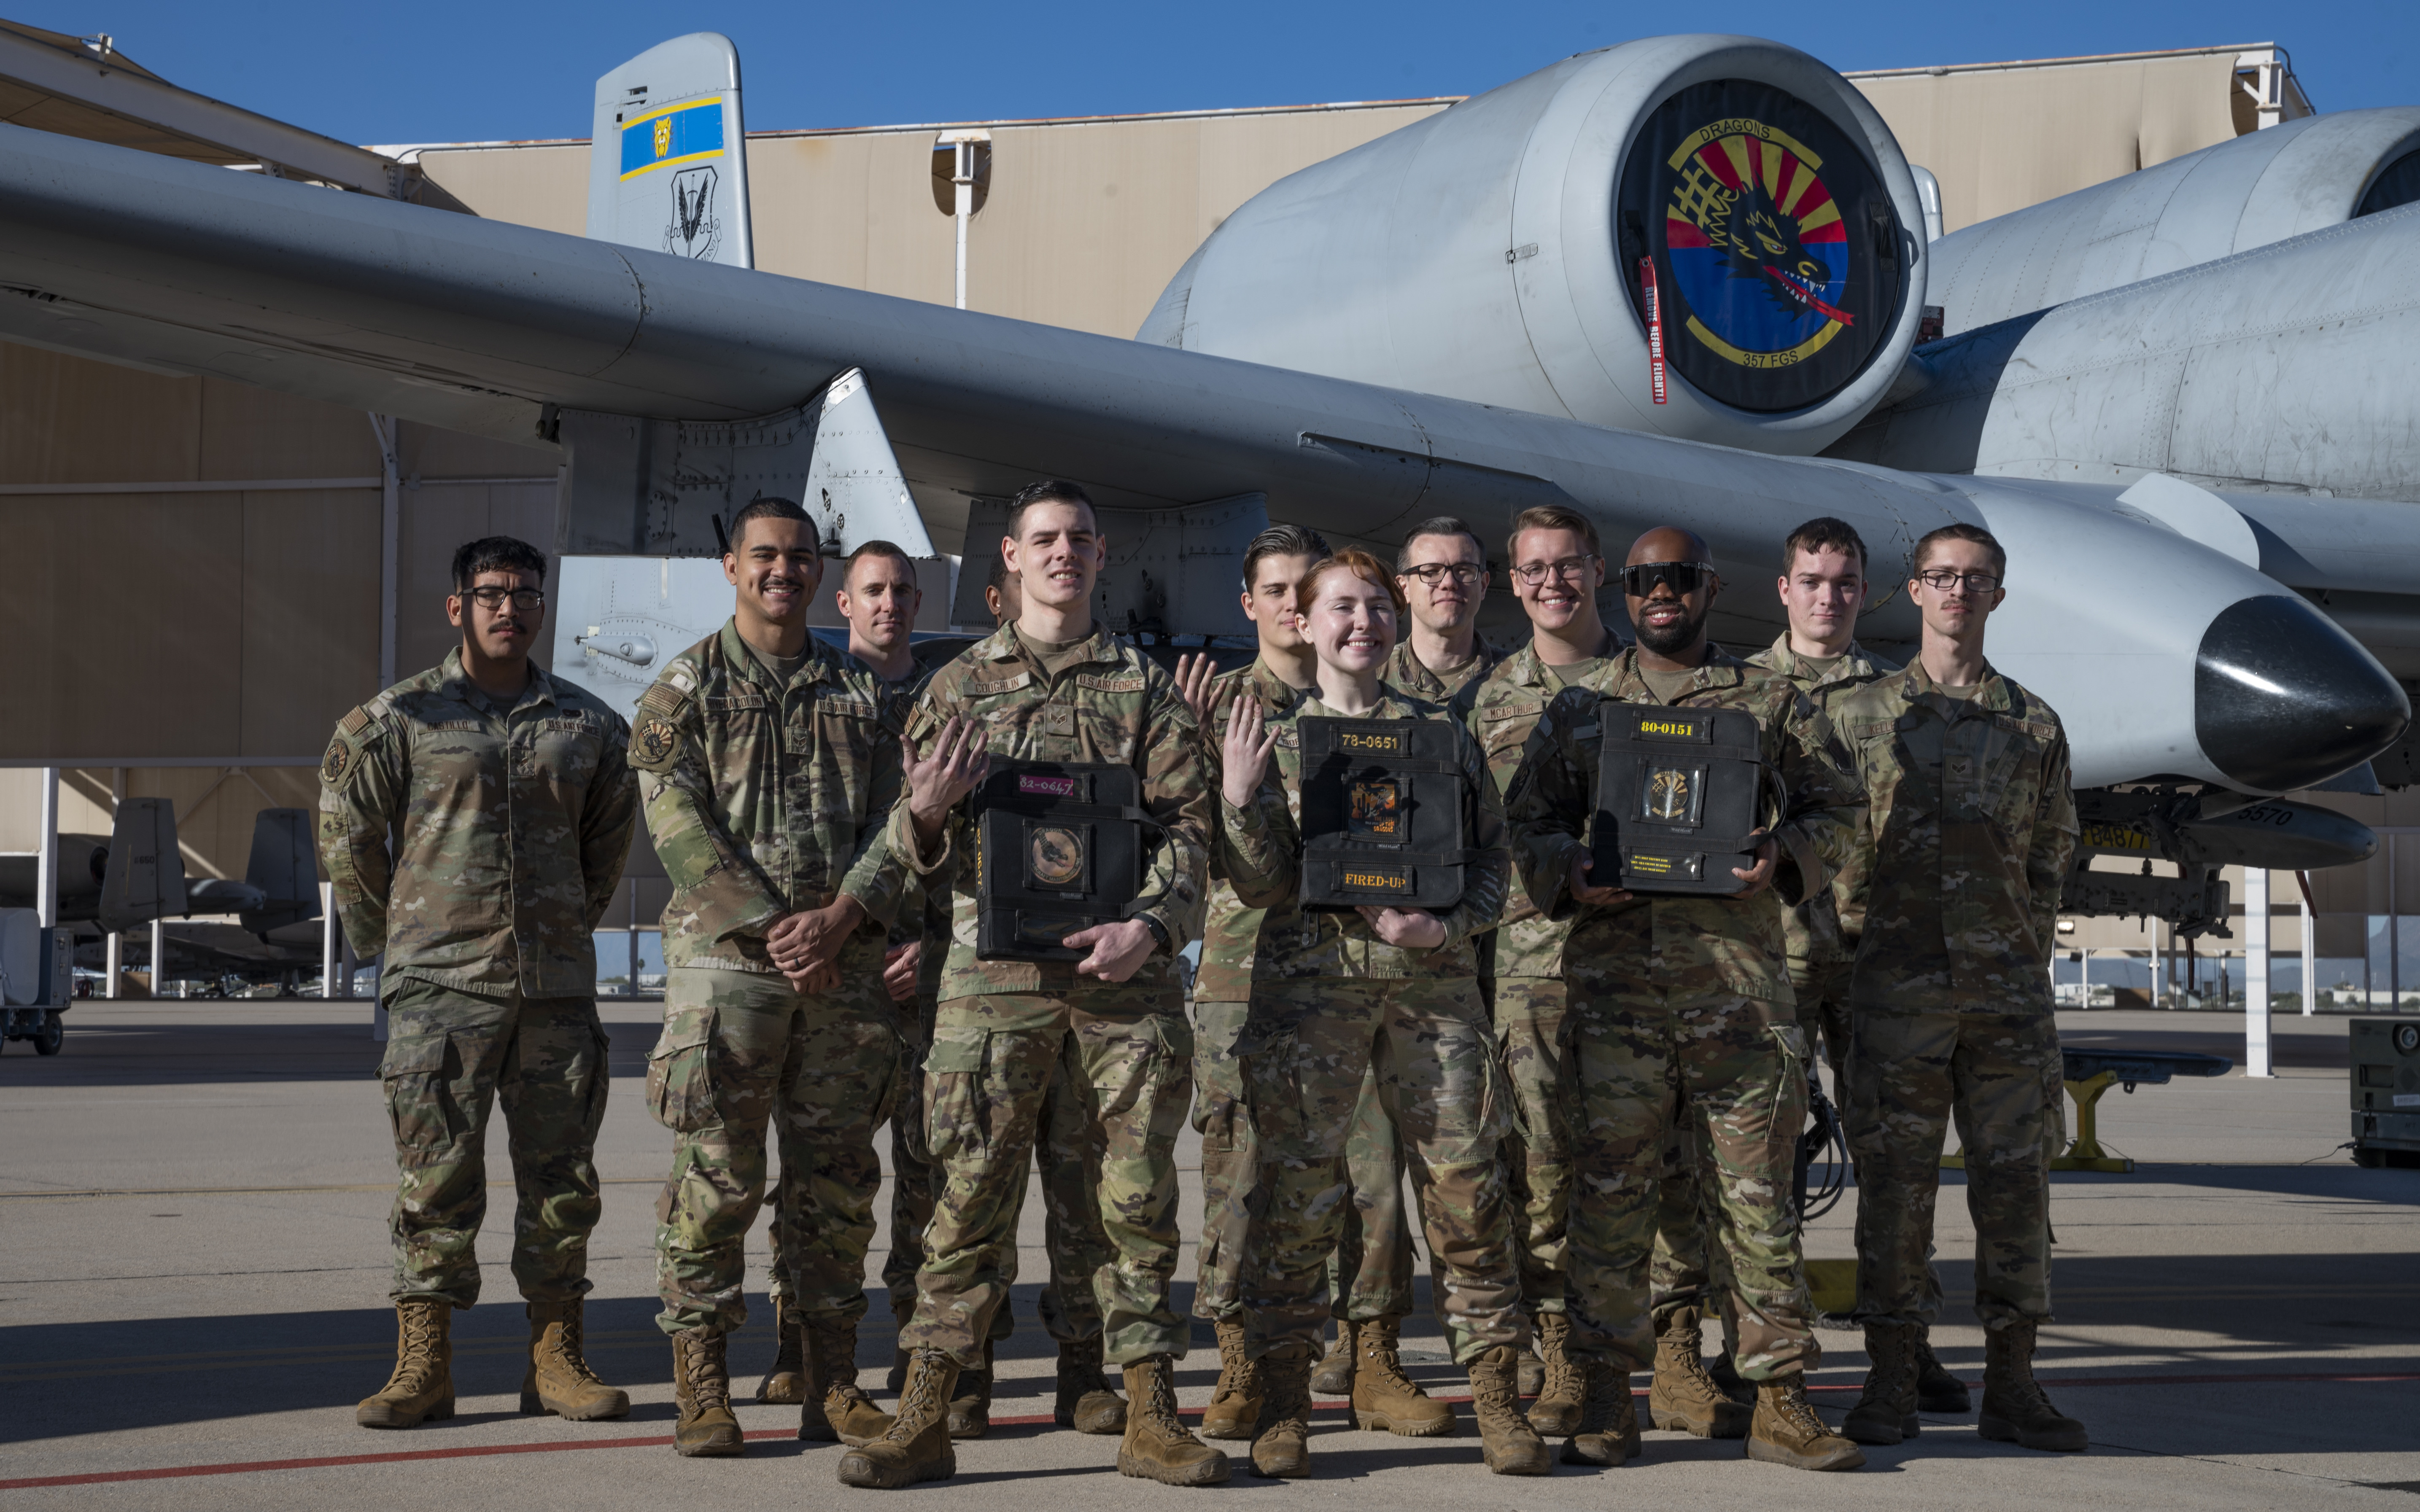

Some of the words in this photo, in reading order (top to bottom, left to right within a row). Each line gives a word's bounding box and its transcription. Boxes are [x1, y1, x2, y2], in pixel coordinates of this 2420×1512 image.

[1699, 119, 1771, 142] DRAGONS
[1644, 286, 1657, 323] REMOVE
[1649, 326, 1661, 359] BEFORE
[1743, 353, 1765, 368] 357
[1772, 351, 1798, 365] FGS
[1653, 362, 1664, 397] FLIGHT!
[976, 678, 1019, 693] COUGHLIN
[1080, 674, 1095, 687] U.S.
[1097, 679, 1110, 690] AIR
[1113, 679, 1142, 691] FORCE
[707, 698, 734, 709] RIVERA
[736, 697, 762, 708] COLON
[835, 703, 847, 713] AIR
[850, 705, 875, 717] FORCE
[1490, 703, 1533, 719] MCARTHUR
[428, 721, 468, 731] CASTILLO
[564, 722, 575, 730] AIR
[577, 723, 600, 736] FORCE
[1641, 721, 1692, 736] 80-0151
[1870, 718, 1901, 735] KELLEY
[2013, 720, 2024, 732] AIR
[2027, 723, 2053, 737] FORCE
[1342, 734, 1397, 749] 78-0651
[1019, 777, 1073, 795] 82-0647
[2238, 807, 2293, 826] 5570
[1038, 827, 1063, 836] DRAGON
[140, 856, 154, 864] 650
[1345, 873, 1406, 888] FIRED-UP
